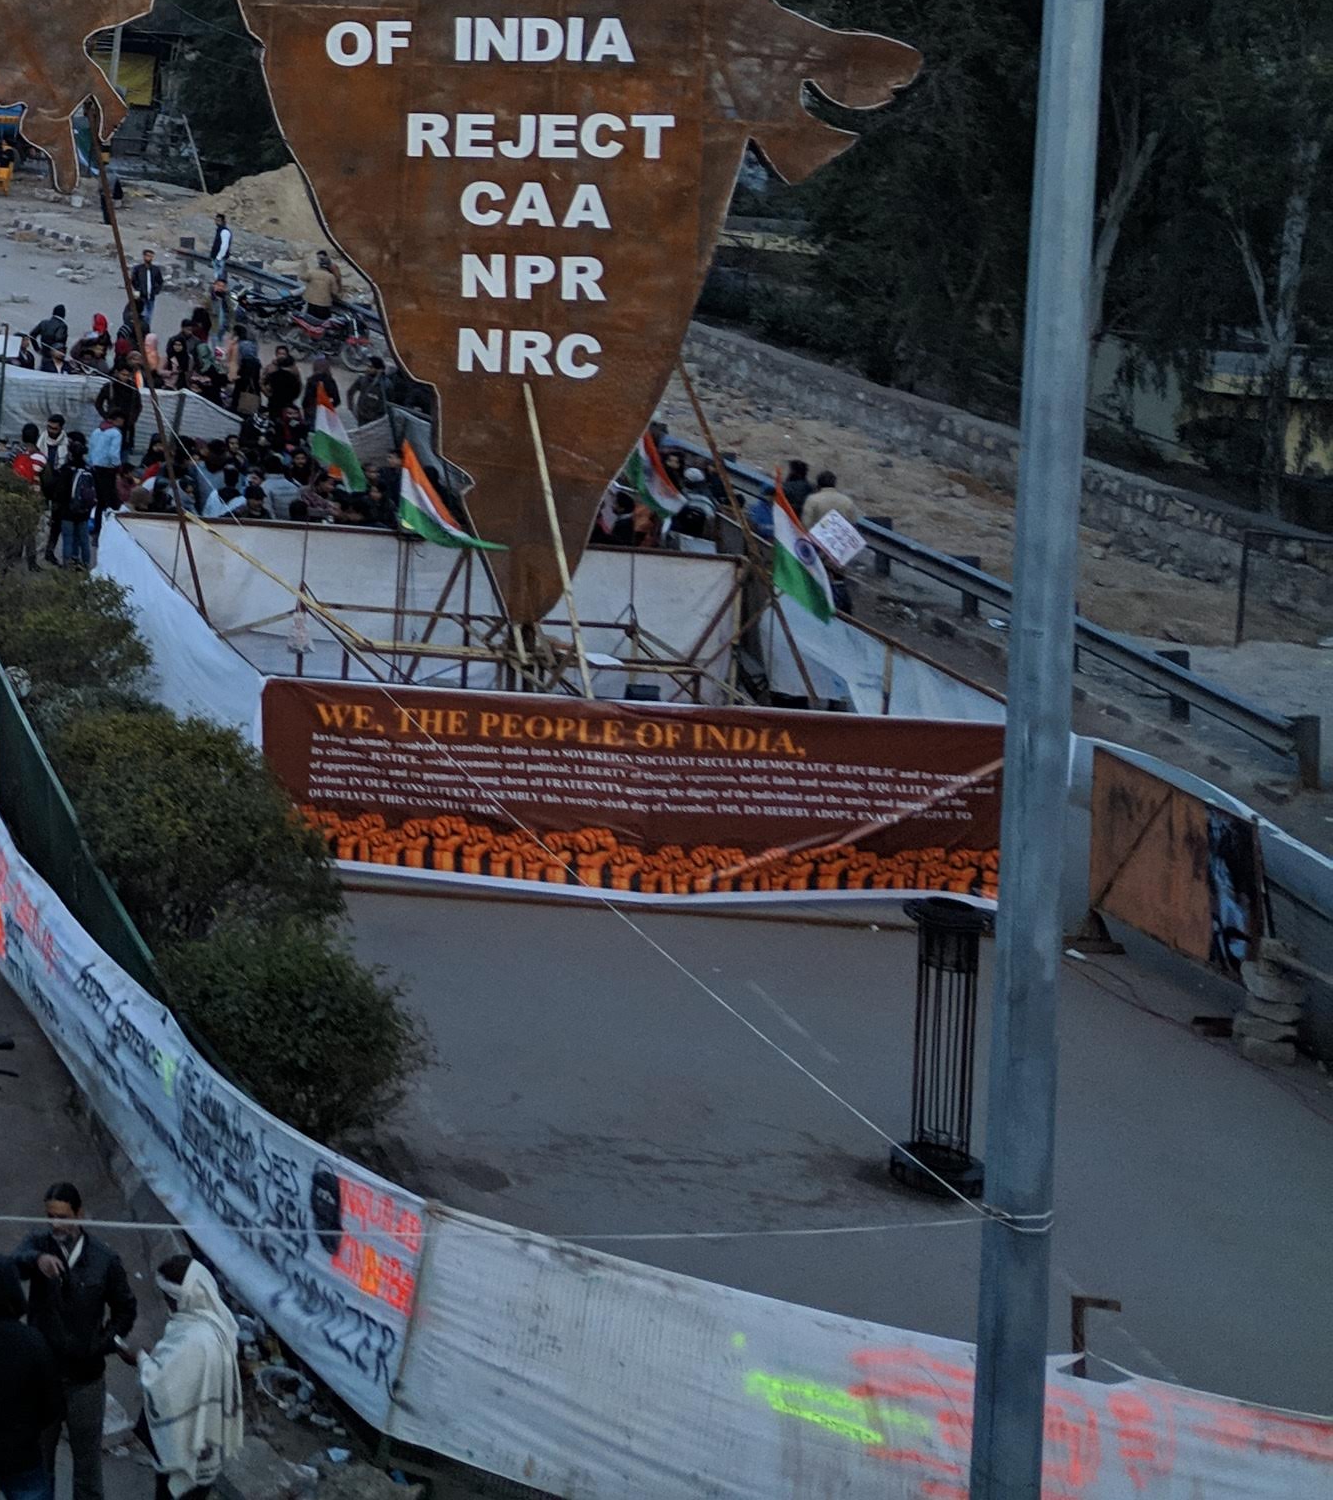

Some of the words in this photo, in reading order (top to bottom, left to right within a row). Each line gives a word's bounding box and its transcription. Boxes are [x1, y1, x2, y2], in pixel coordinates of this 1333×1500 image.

[325, 19, 412, 67] OF
[454, 16, 635, 63] INDIA
[406, 112, 675, 160] REJECT
[460, 180, 611, 229] CAA
[461, 254, 606, 301] NPR
[458, 327, 602, 378] NRC
[316, 702, 384, 733] WE,
[393, 707, 469, 736] THE
[480, 711, 626, 747] PEOPLE
[635, 722, 683, 750] OF
[692, 722, 808, 757] INDIA,
[363, 778, 392, 790] OUR
[545, 777, 622, 794] FRATERNITY
[561, 748, 634, 764] SOVEREIGN
[635, 754, 695, 767] SOCIALIST
[697, 756, 753, 770] SECULAR
[753, 759, 834, 774] DEMOCRATIC
[836, 763, 898, 778] REPUBLIC
[574, 764, 627, 779] LIBERTY
[867, 781, 930, 797] EQUALITY
[308, 787, 377, 801] OURSELVES
[378, 793, 408, 805] THIS
